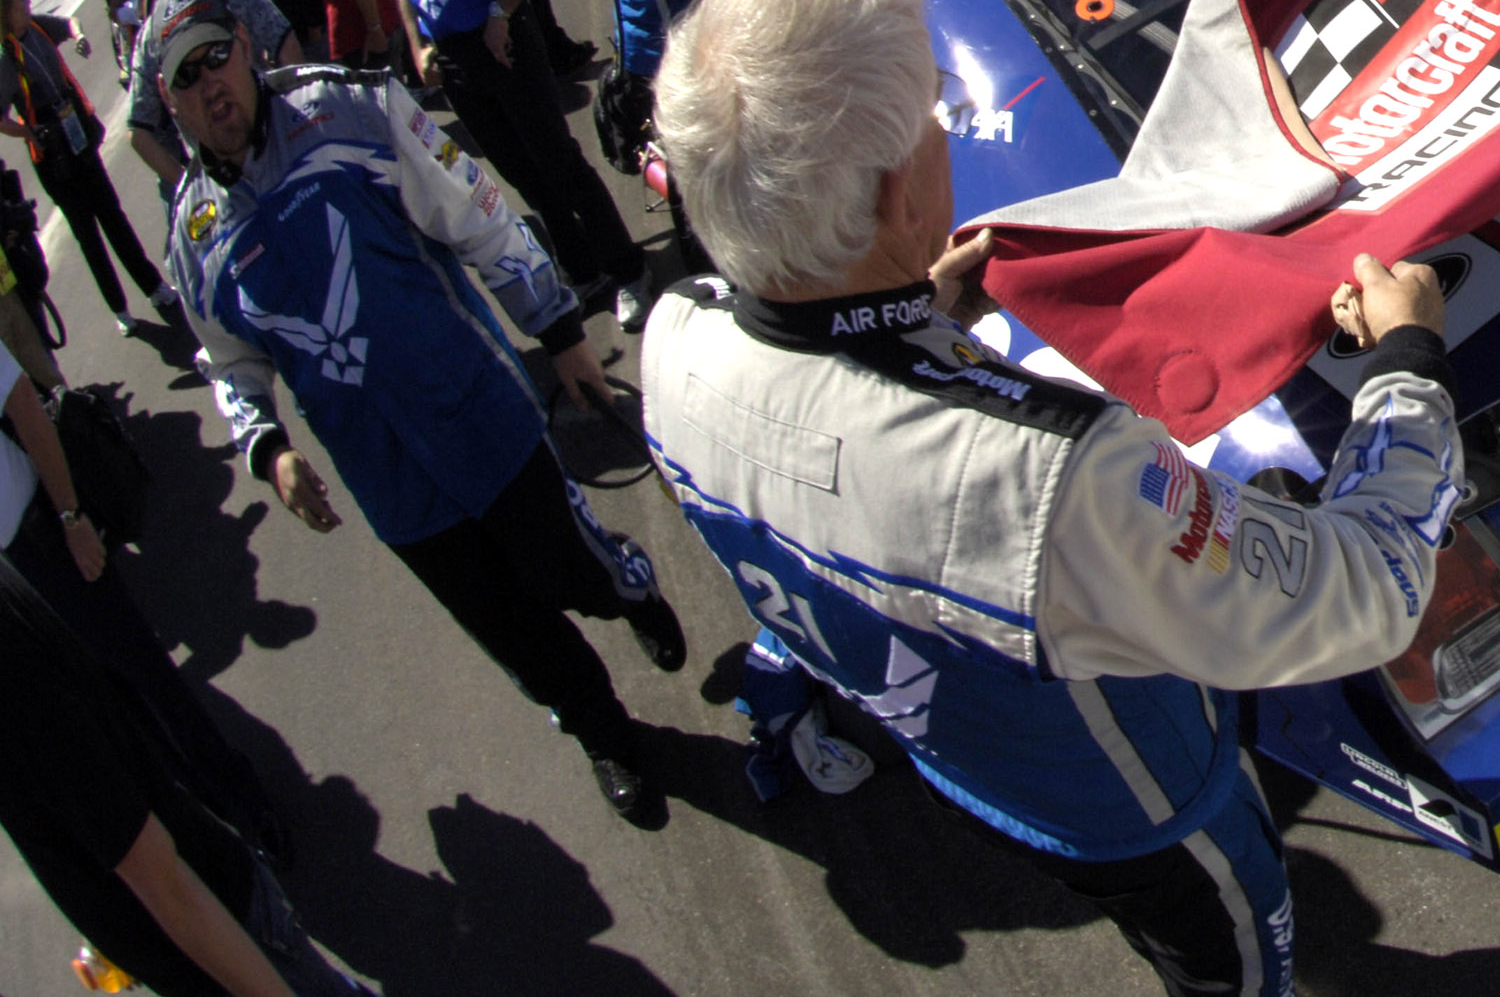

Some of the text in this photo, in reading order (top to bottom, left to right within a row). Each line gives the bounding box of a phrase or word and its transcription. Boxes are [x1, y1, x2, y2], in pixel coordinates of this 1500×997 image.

[830, 294, 932, 336] AIR FORC
[1240, 494, 1309, 599] 21
[738, 560, 838, 663] 21
